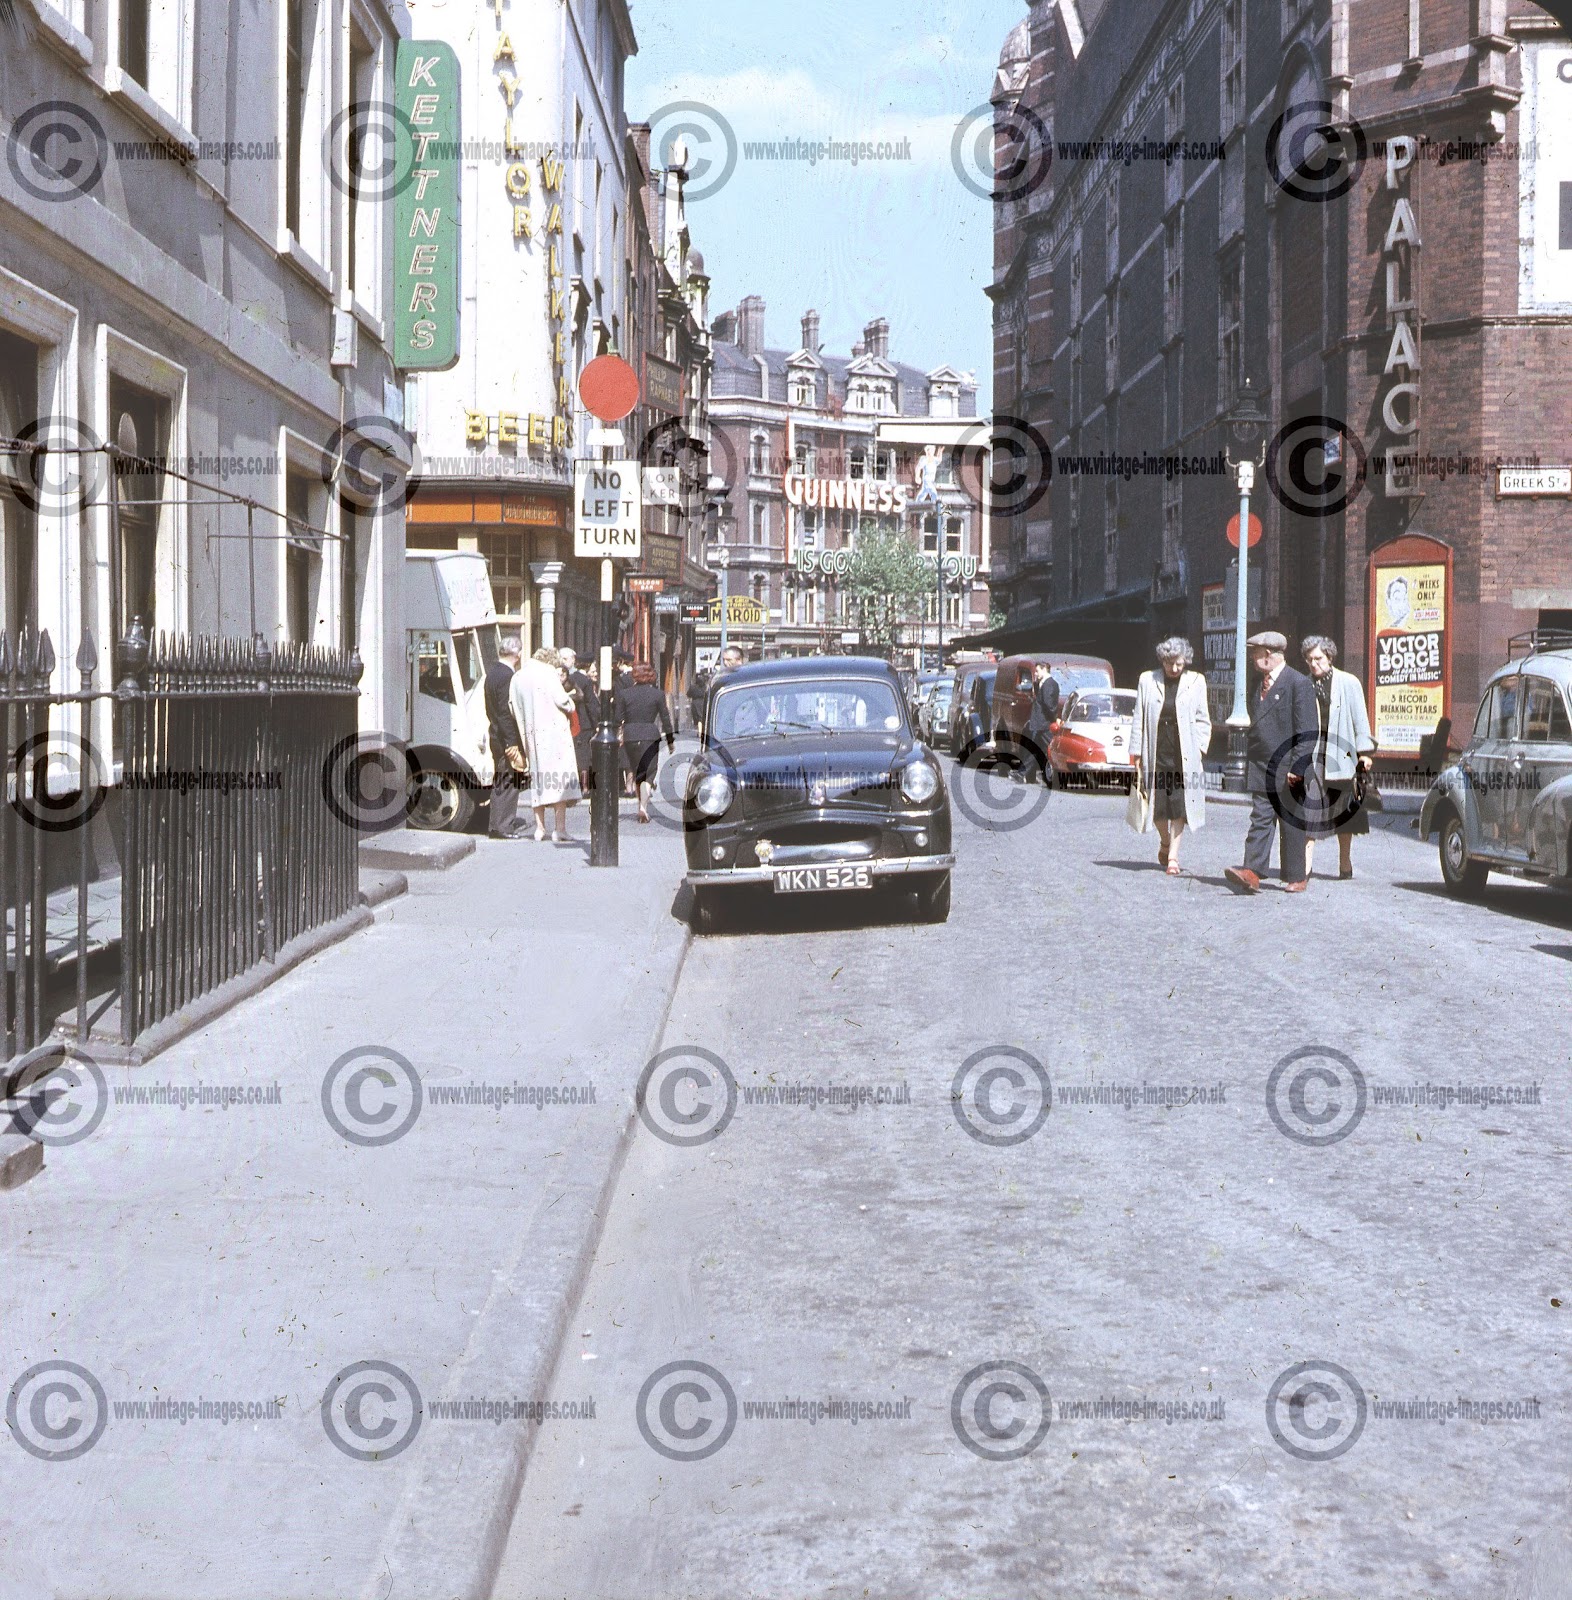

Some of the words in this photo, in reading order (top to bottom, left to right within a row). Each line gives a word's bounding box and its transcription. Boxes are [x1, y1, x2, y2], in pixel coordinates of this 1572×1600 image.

[408, 56, 440, 350] KETTNERS
[541, 157, 570, 408] WALKER
[1382, 134, 1422, 497] PALACE
[593, 472, 622, 490] NO
[785, 465, 907, 513] GUINNESS
[1504, 476, 1544, 488] GREEK
[582, 500, 634, 517] LEFT
[579, 527, 636, 545] TURN
[797, 549, 815, 575] IS
[931, 554, 978, 580] YOU
[1418, 579, 1440, 589] WEEKS
[1417, 591, 1437, 601] ONLY
[1380, 633, 1439, 655] VICTOR
[1379, 650, 1440, 671] BORGE
[1410, 673, 1417, 681] IN
[1399, 694, 1428, 703] RECORD
[1380, 705, 1413, 714] BREAKING
[1415, 705, 1438, 714] YEARS
[1396, 713, 1433, 721] BROADWAY
[778, 870, 821, 890] WKN
[826, 866, 869, 888] 526
